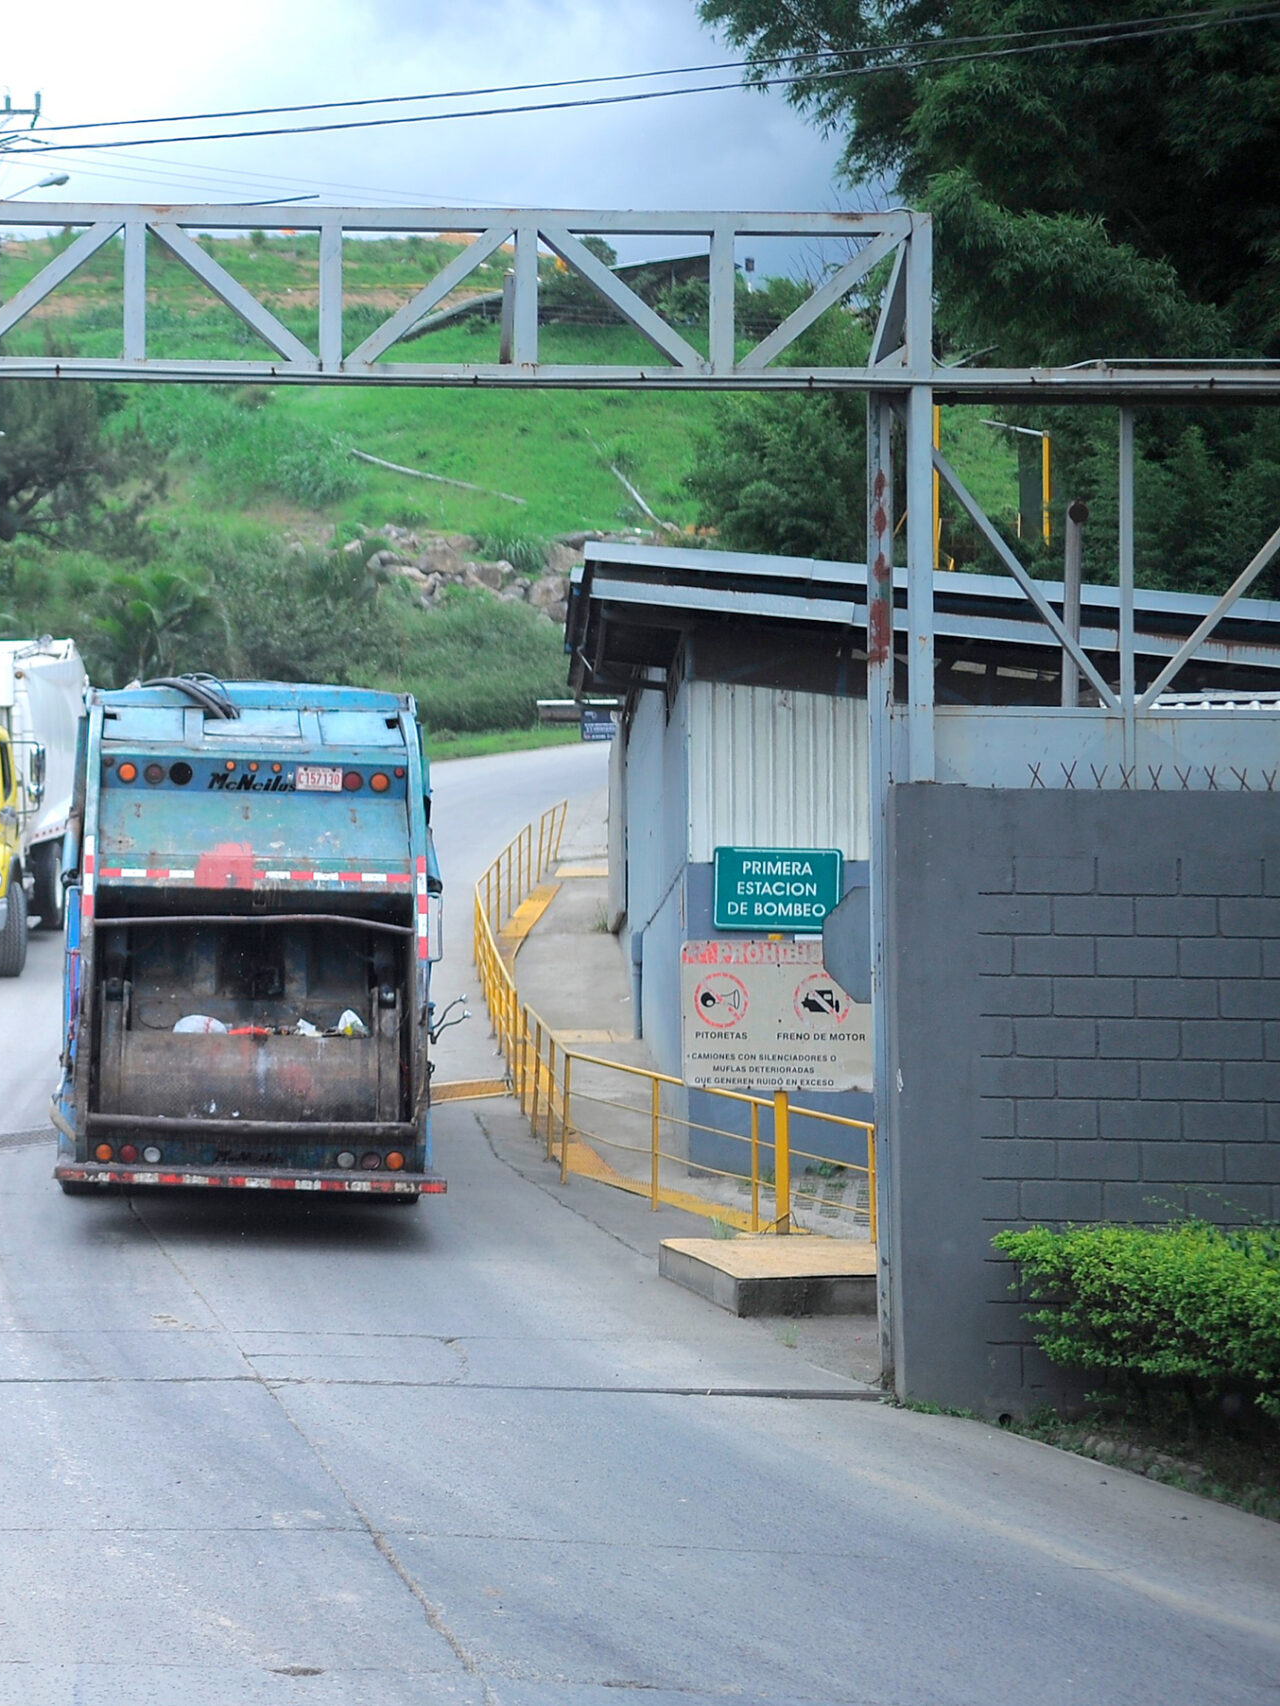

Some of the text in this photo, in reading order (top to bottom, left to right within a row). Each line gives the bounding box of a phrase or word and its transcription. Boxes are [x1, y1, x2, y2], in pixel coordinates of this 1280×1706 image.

[207, 771, 296, 793] McNeilus
[742, 860, 813, 876] PRIMERA
[737, 881, 817, 897] ESTACION
[727, 902, 826, 918] DE BOMBEO
[695, 1031, 748, 1040] PITORETAS
[776, 1032, 866, 1042] FRENO DE MOTOR
[737, 1053, 756, 1061] CON
[758, 1053, 828, 1062] SILENCIADORES
[830, 1054, 837, 1062] O
[712, 1065, 815, 1074] MUFLAS DETERIORADAS
[694, 1076, 712, 1084] QUE
[714, 1077, 754, 1085] GENEREN
[800, 1079, 835, 1087] EXCESO
